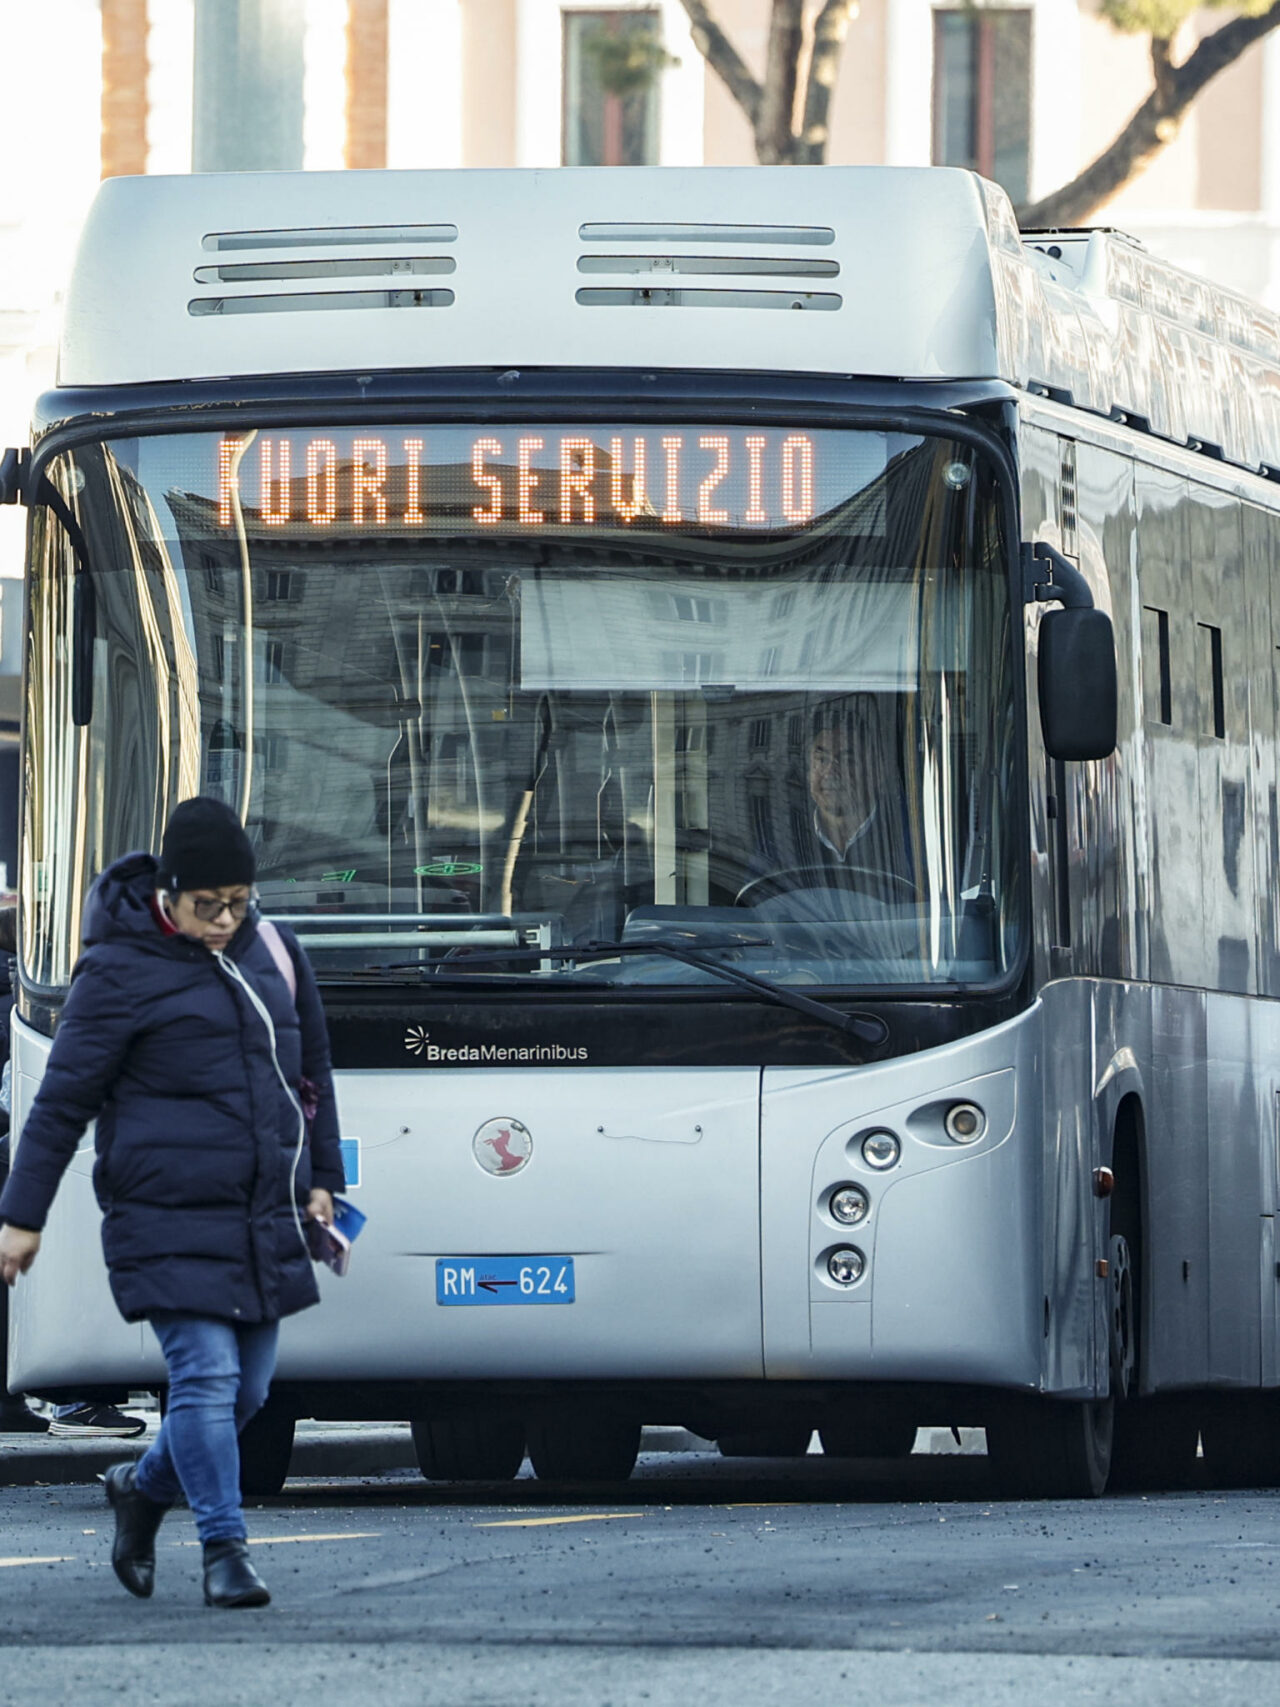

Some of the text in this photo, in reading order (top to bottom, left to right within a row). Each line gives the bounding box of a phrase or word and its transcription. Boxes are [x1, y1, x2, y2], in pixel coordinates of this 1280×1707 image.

[220, 437, 812, 525] FUORI SERVIZIO
[427, 1044, 588, 1061] BredaMenarinibus
[444, 1266, 568, 1295] RM 624
